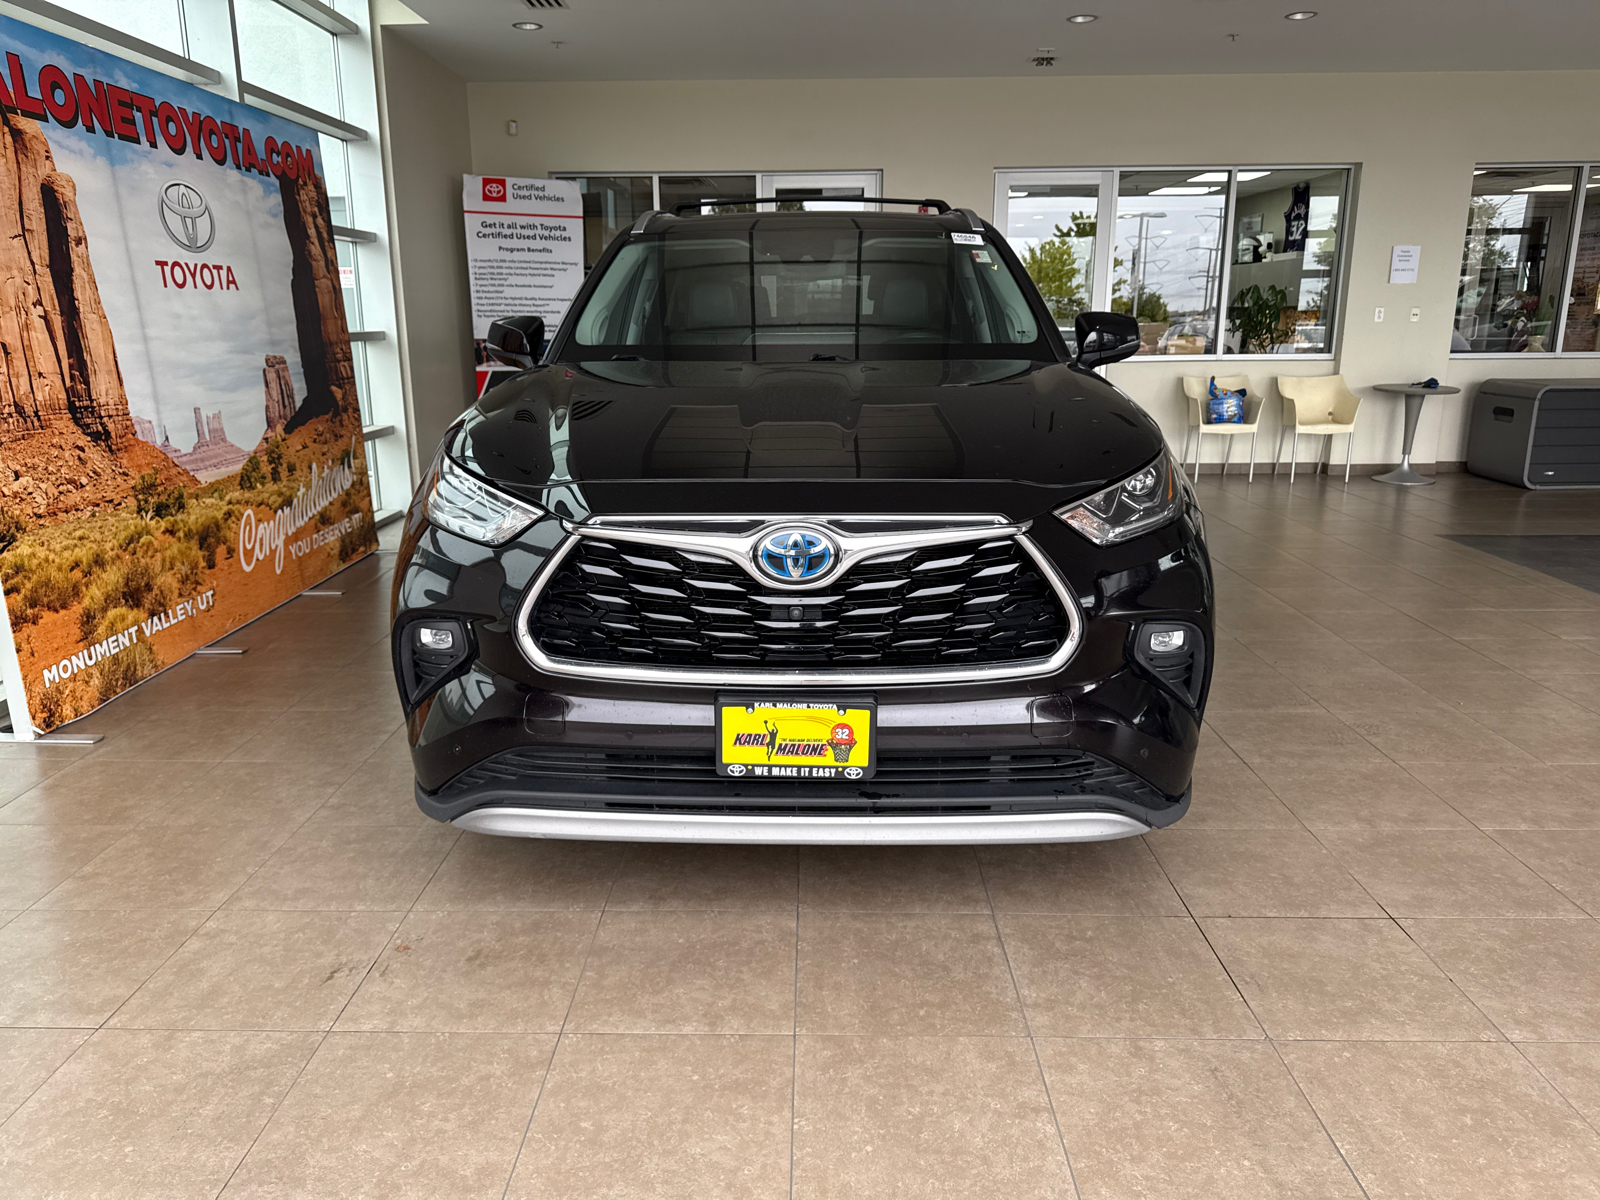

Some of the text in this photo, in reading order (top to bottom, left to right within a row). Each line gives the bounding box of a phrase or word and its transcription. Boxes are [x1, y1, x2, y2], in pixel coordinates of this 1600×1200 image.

[511, 183, 545, 192] Certified
[512, 192, 565, 202] Used Vehicles
[480, 221, 567, 233] Get it all with Toyota
[476, 231, 572, 242] Certified Used Vehicles
[155, 260, 239, 290] TOYOTA
[289, 538, 311, 559] YOU
[312, 518, 352, 549] DESERVE
[42, 589, 215, 688] MONUMENT VALLEY, UT
[732, 732, 769, 747] KARL
[835, 728, 850, 740] 32
[774, 742, 828, 758] MALONE
[754, 766, 837, 778] WE MAKE IT EASY
